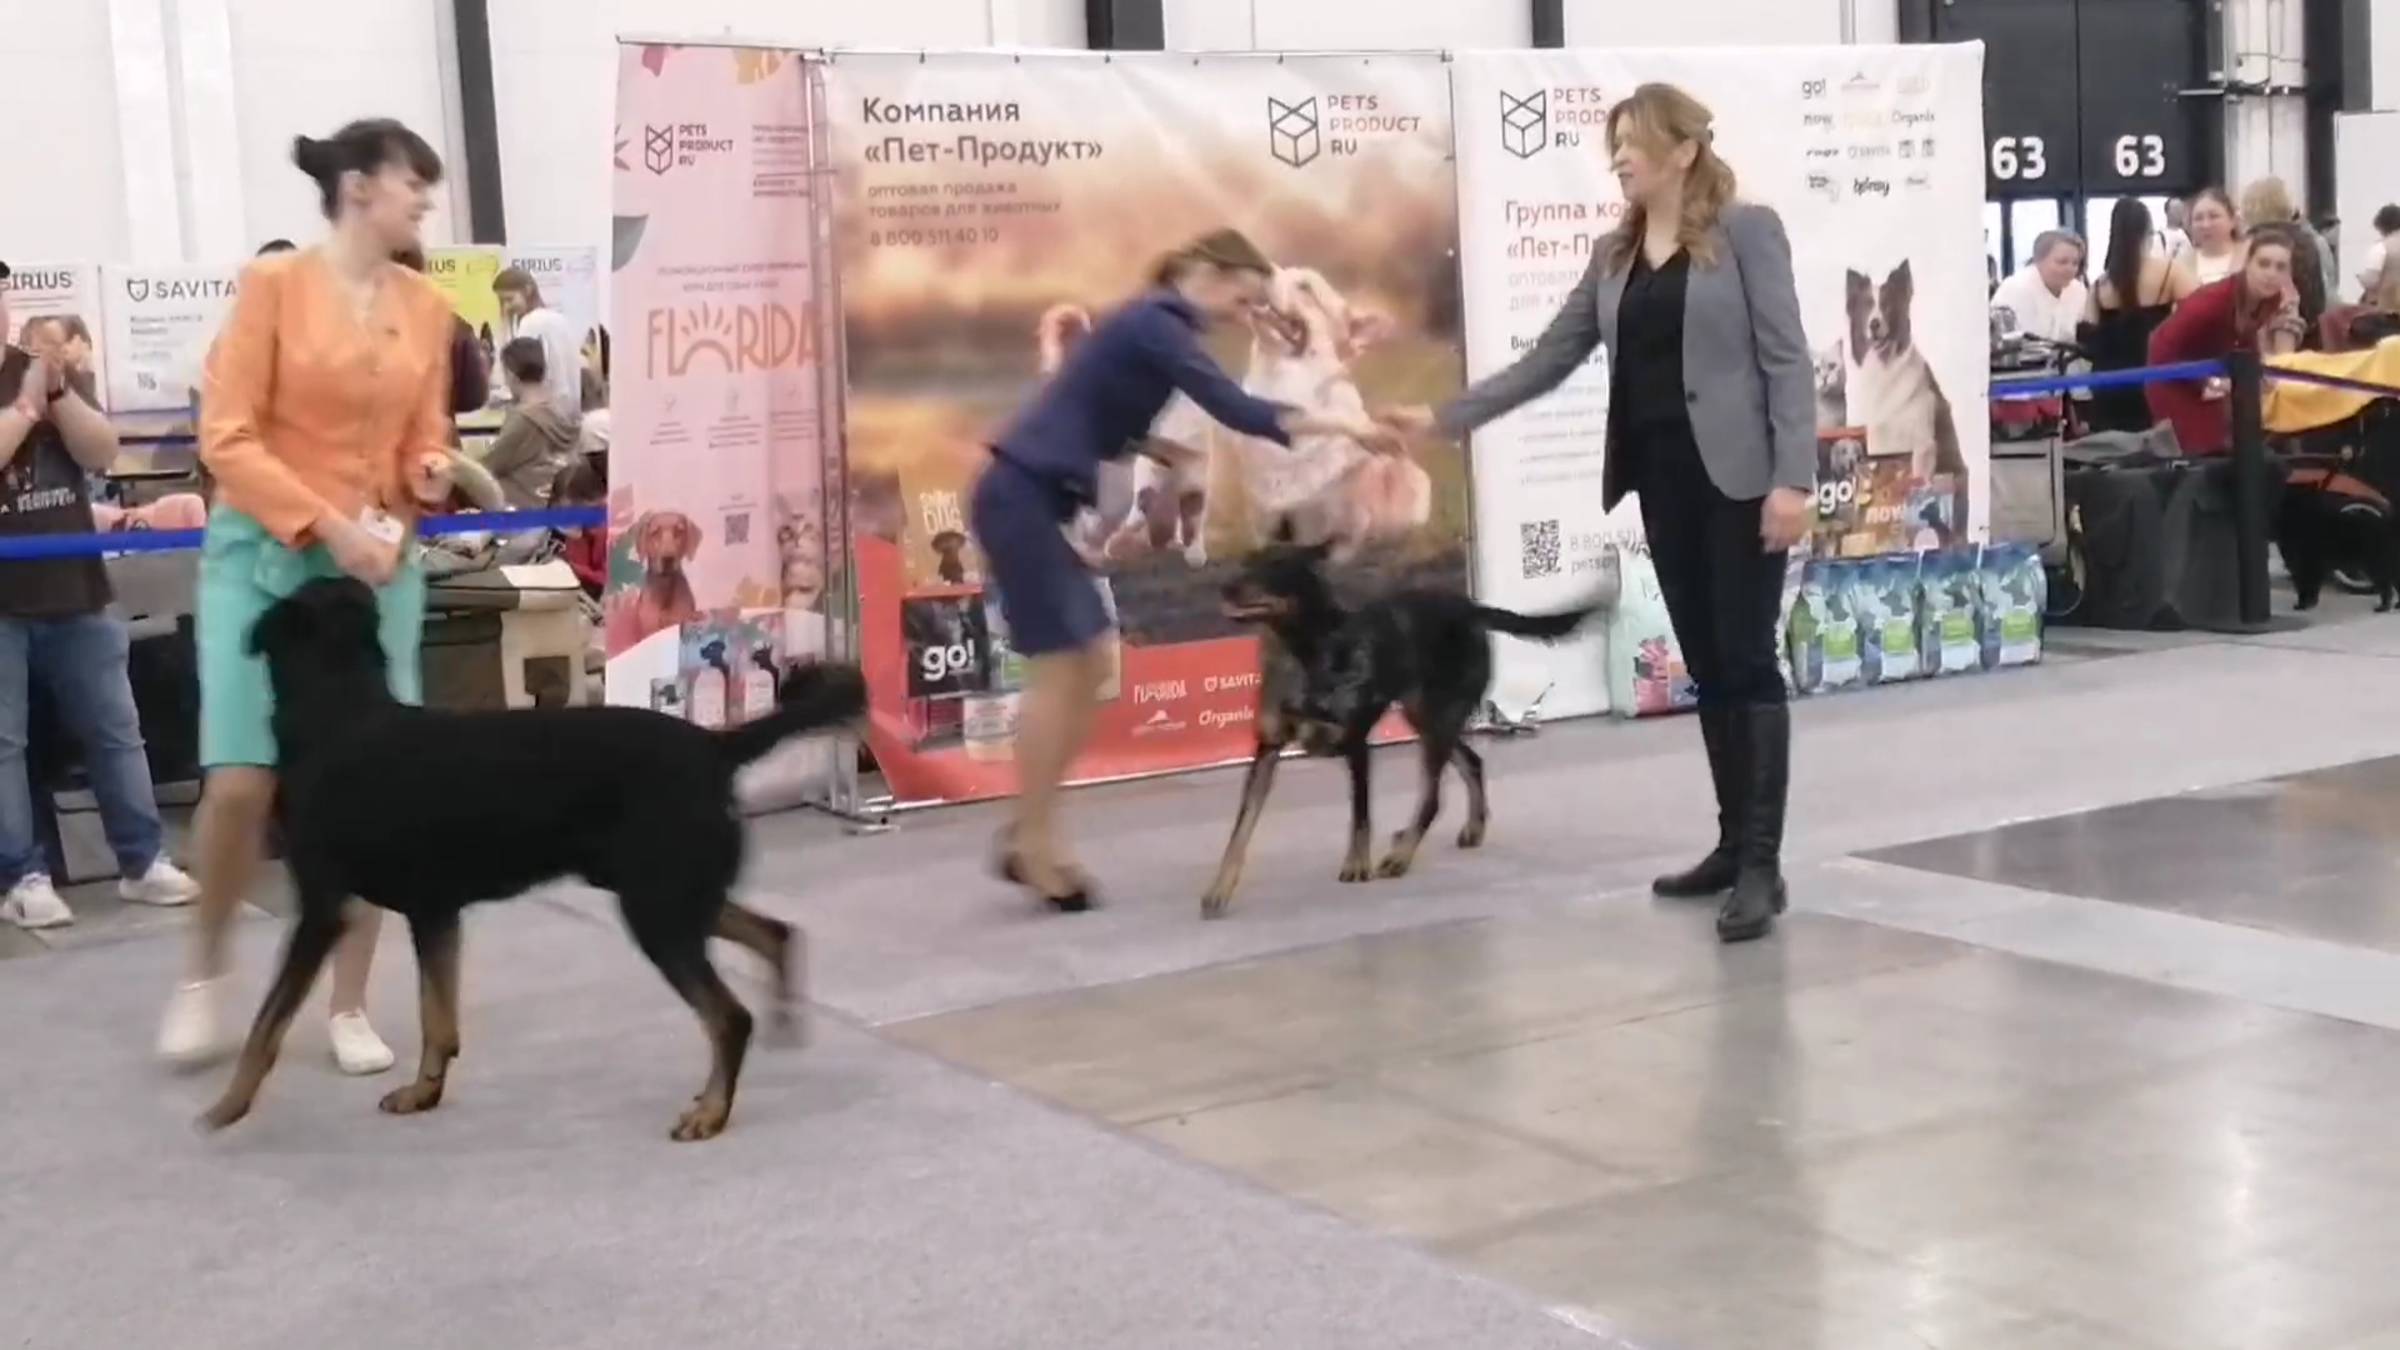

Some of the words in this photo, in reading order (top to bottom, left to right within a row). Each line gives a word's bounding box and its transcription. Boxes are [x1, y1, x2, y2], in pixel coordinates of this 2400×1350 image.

[1327, 94, 1378, 111] PETS
[1554, 87, 1602, 103] PETS
[863, 97, 1020, 123] Компания
[1555, 109, 1608, 125] PROD
[679, 124, 707, 136] PETS
[1330, 116, 1421, 132] PRODUCT
[679, 139, 734, 152] PRODUCT
[1331, 139, 1357, 155] RU
[1555, 132, 1580, 147] RU
[864, 135, 1103, 168] «Пет-Продукт»
[1991, 137, 2046, 180] 63
[2115, 135, 2166, 177] 63
[868, 183, 938, 198] оптовая
[943, 181, 1017, 198] продажа
[1505, 200, 1587, 228] Группа
[1596, 202, 1626, 219] ко
[955, 227, 978, 244] 40
[982, 227, 999, 242] 10
[1507, 233, 1597, 259] «Пет-П
[156, 279, 238, 300] SAVITA
[922, 639, 974, 681] go!
